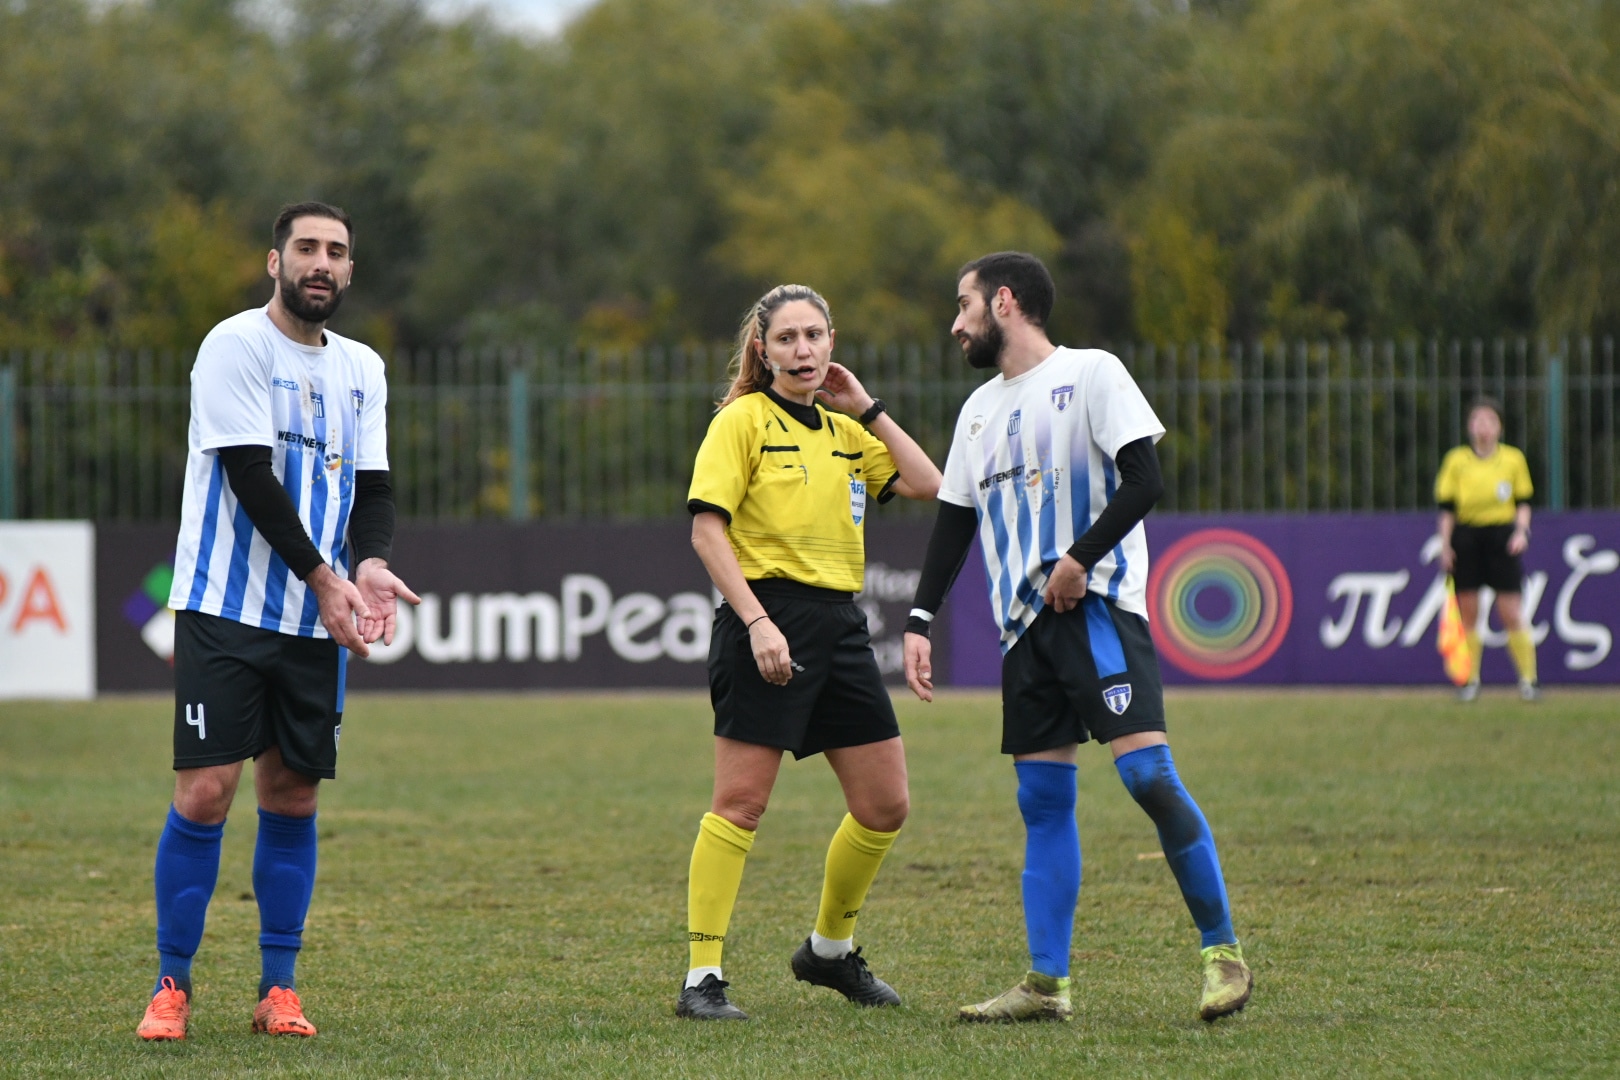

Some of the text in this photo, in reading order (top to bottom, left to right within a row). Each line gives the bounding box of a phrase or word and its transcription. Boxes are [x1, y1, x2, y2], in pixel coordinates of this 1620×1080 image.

[979, 464, 1026, 490] WETENERGY
[0, 563, 68, 636] A
[346, 573, 724, 664] oumPea
[186, 703, 206, 740] 4
